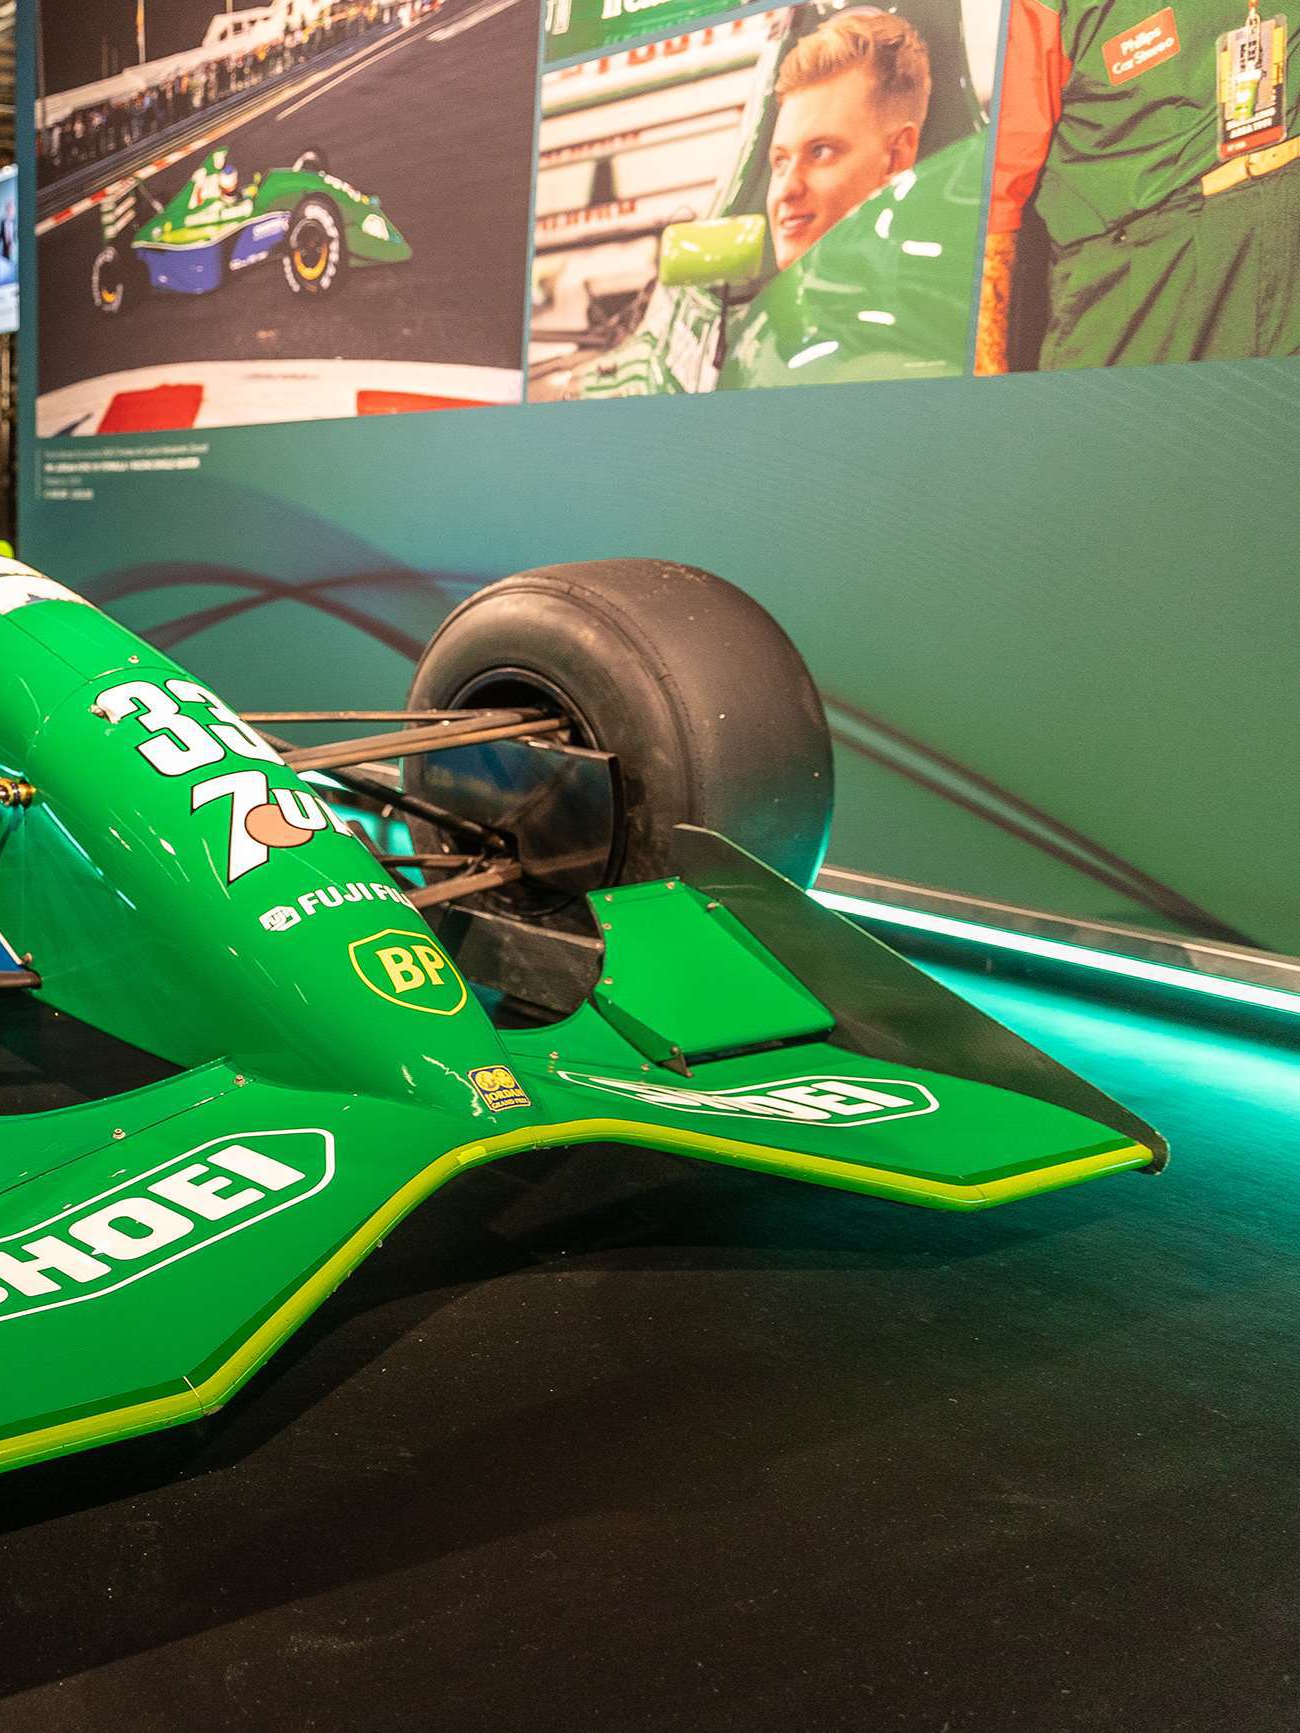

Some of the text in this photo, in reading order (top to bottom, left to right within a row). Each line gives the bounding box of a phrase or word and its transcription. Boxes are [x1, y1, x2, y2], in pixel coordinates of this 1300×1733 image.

[1112, 37, 1175, 75] Car Stereo
[375, 944, 445, 994] BP
[588, 1080, 914, 1121] SHOEI
